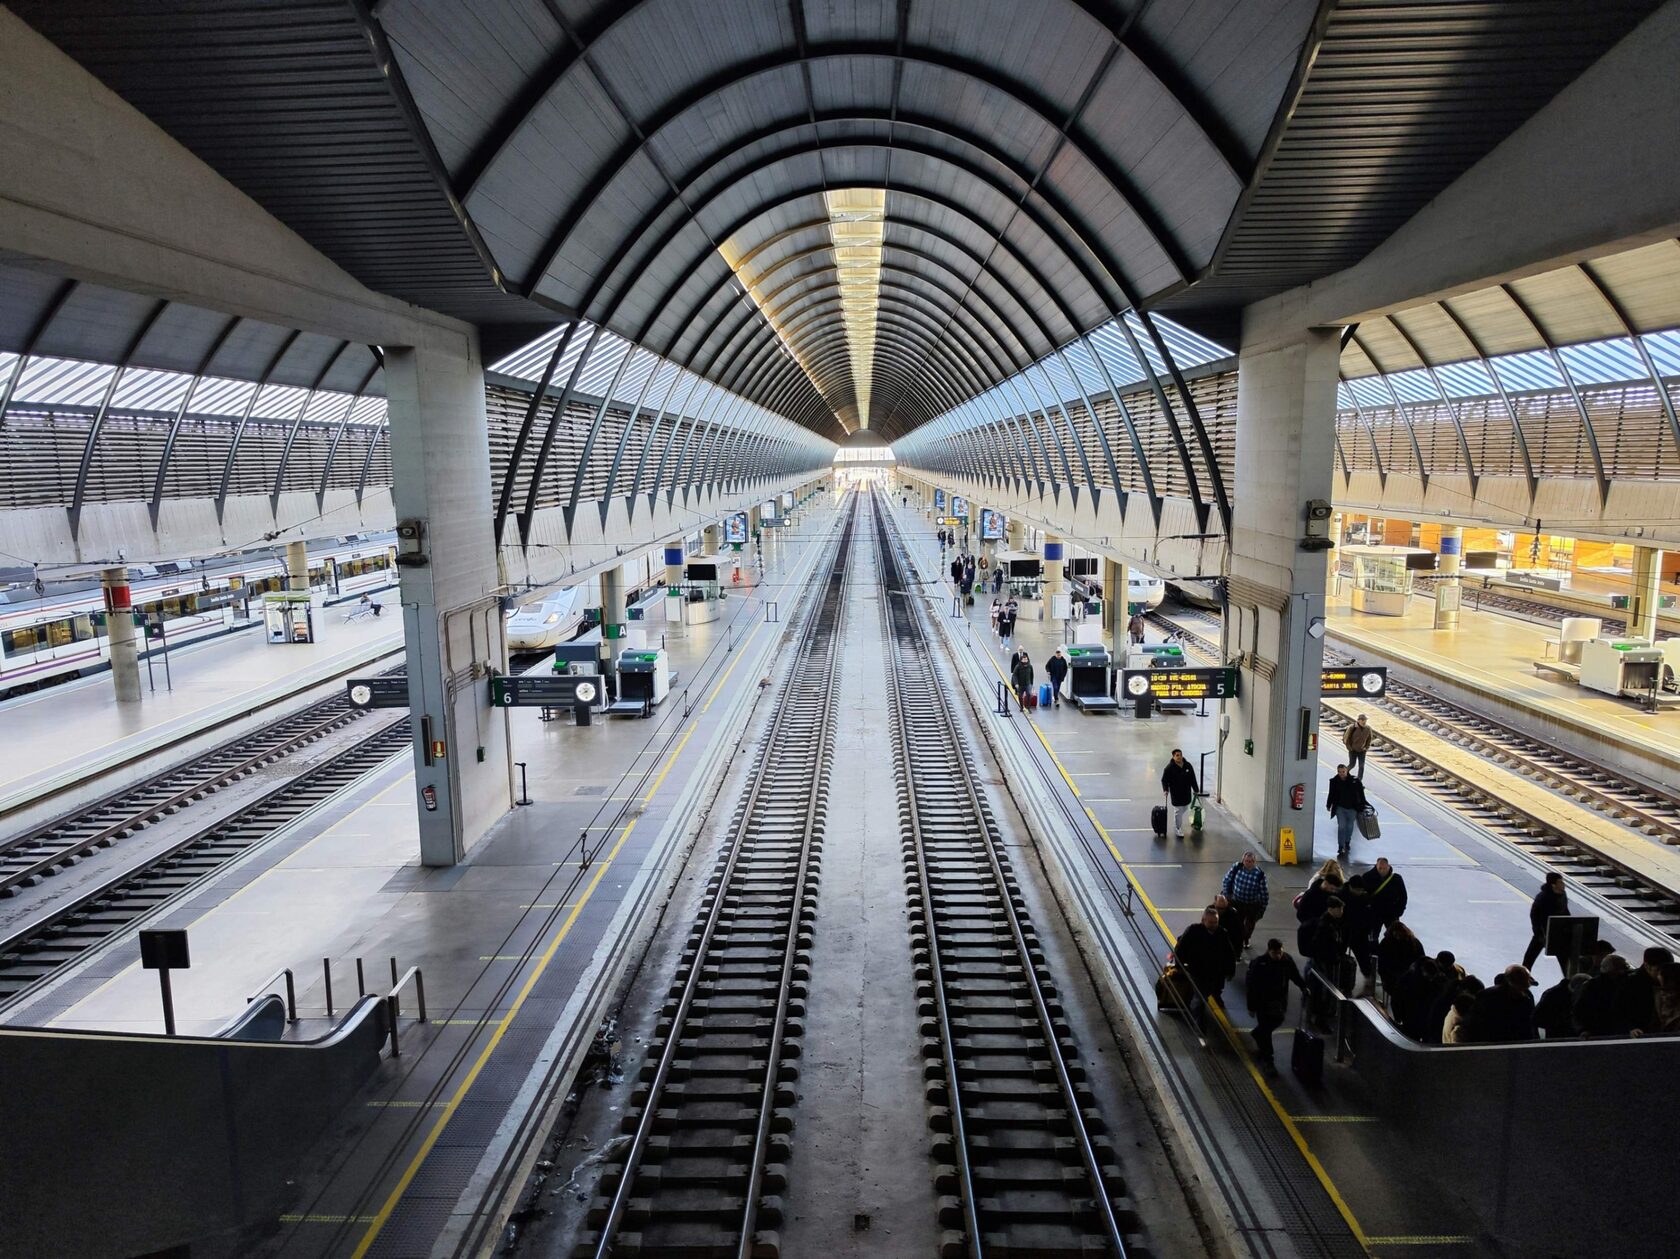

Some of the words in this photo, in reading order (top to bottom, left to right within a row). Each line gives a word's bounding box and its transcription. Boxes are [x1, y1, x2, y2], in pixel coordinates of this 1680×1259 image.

[620, 626, 626, 636] A
[1217, 683, 1225, 695] 5
[504, 693, 512, 703] 6
